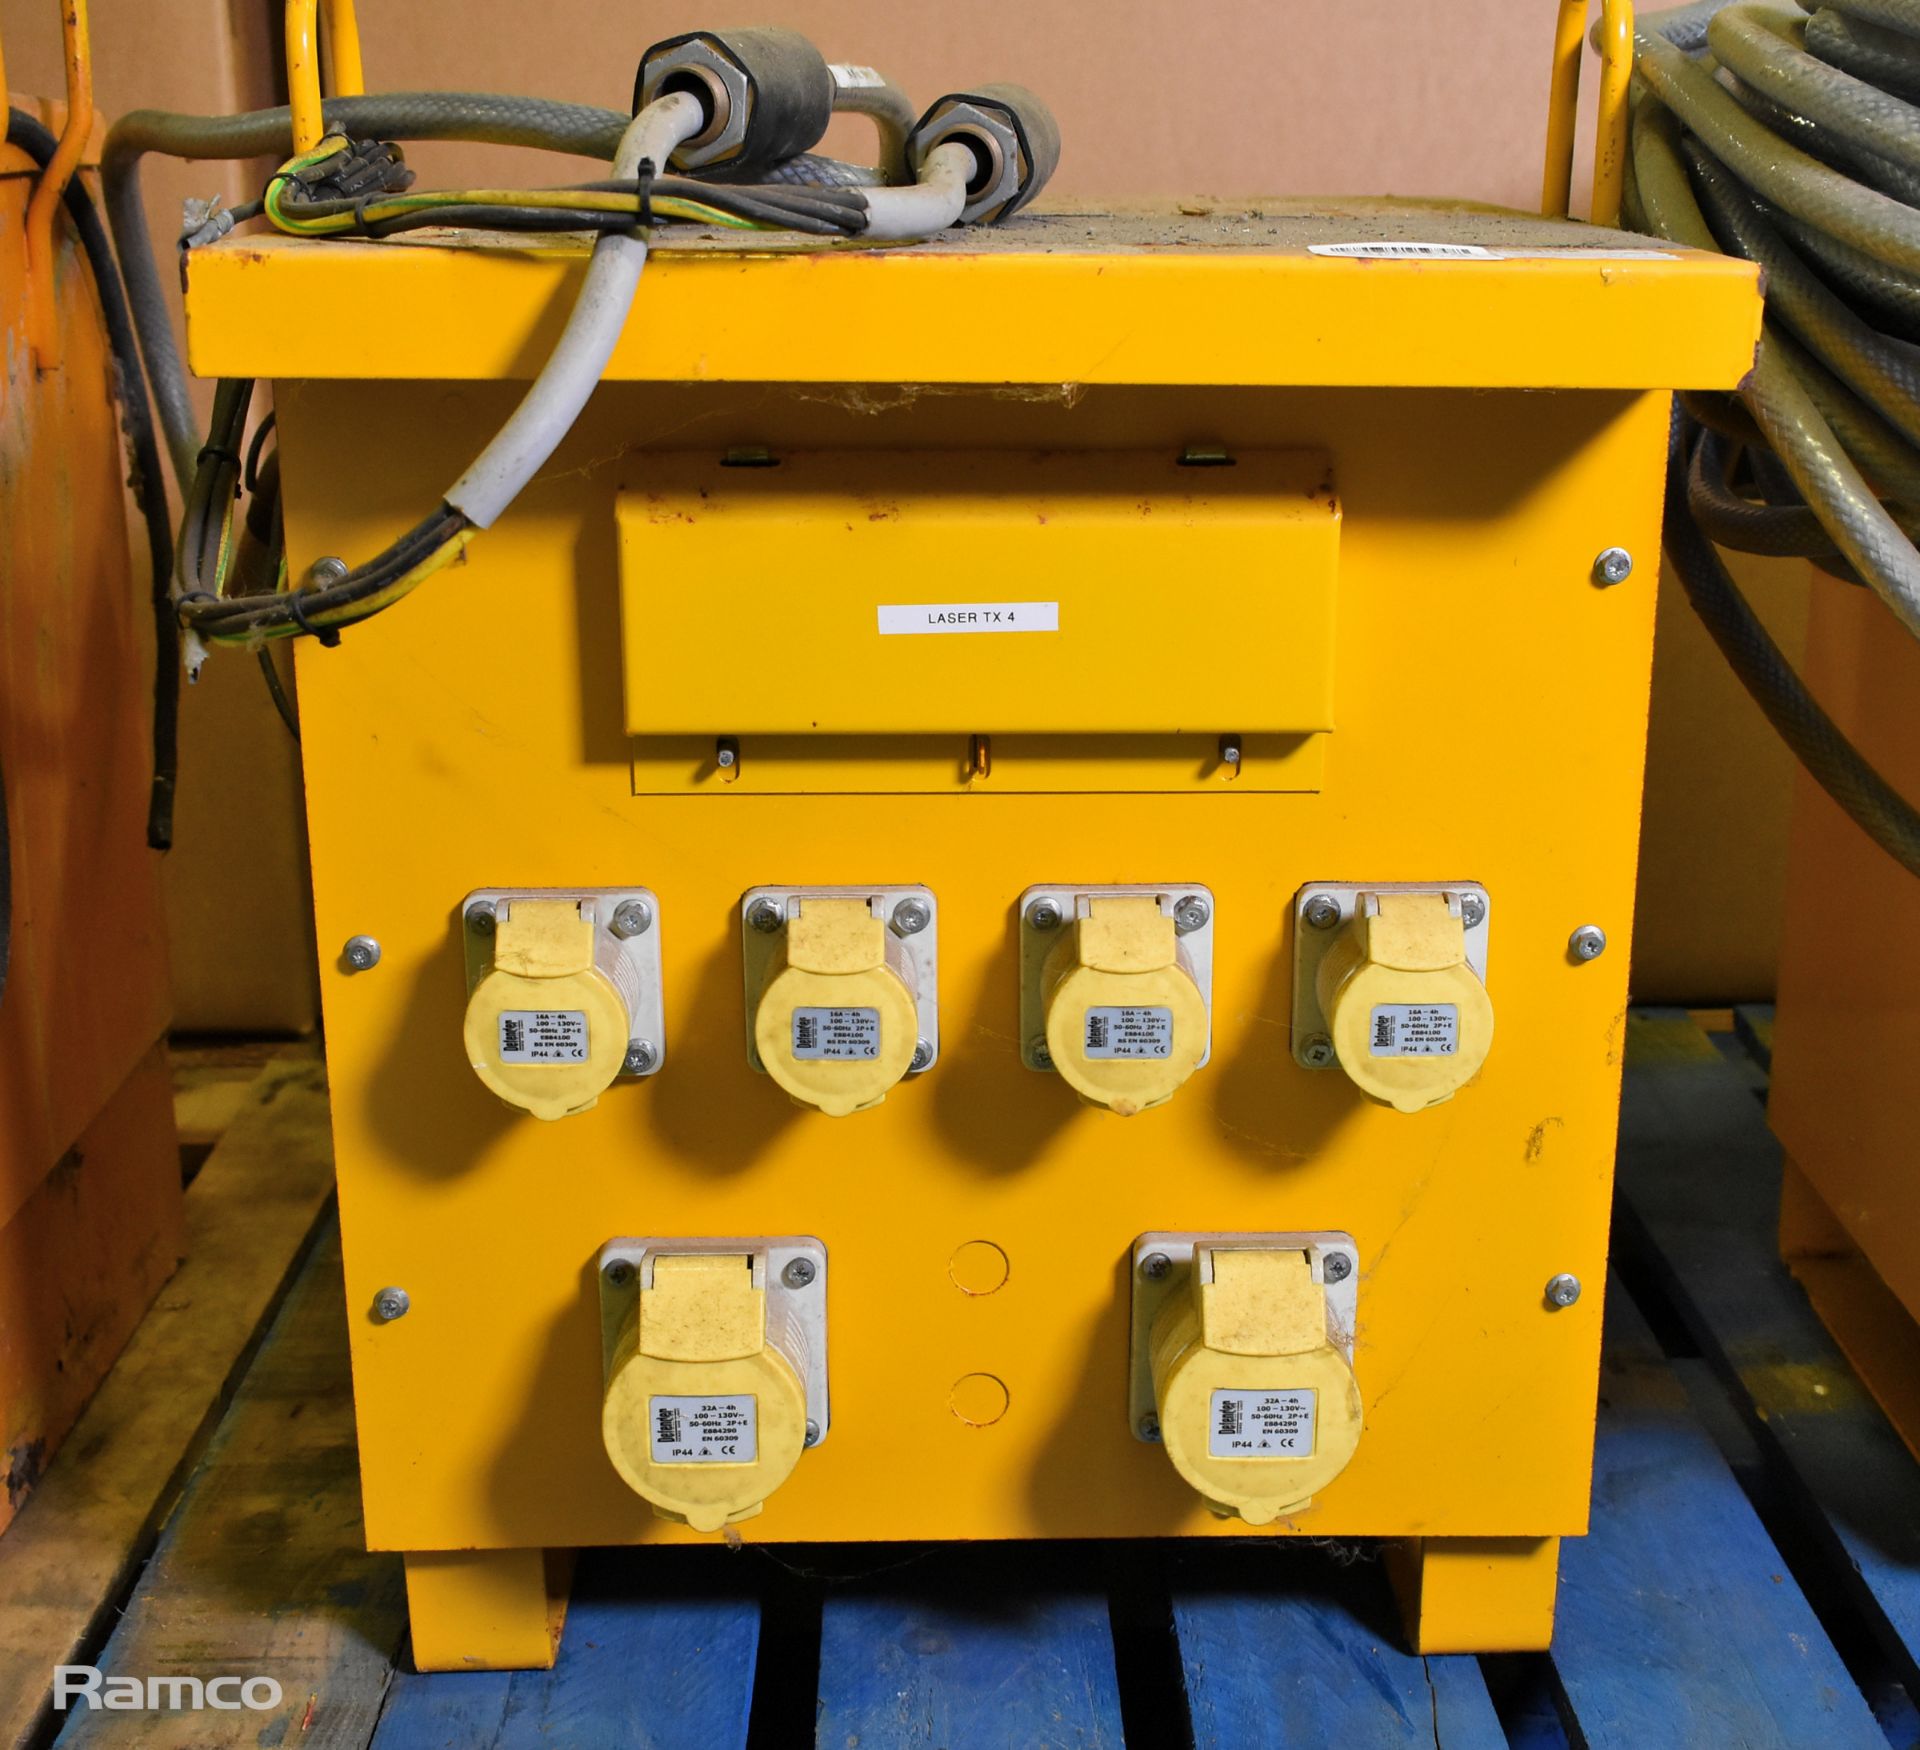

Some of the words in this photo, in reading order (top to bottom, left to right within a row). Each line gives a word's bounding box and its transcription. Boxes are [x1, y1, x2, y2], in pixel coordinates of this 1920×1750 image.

[929, 613, 977, 624] LASER
[984, 612, 1001, 622] TX
[1008, 612, 1014, 621] 4
[503, 1020, 518, 1051] Defender
[796, 1017, 811, 1048] Defender
[1087, 1017, 1102, 1047] Defender
[1374, 1016, 1389, 1046] Defender
[571, 1049, 583, 1057] CE
[864, 1047, 875, 1055] CE
[656, 1408, 675, 1442] Defender
[1219, 1401, 1237, 1434] Defender
[721, 1446, 735, 1454] CE
[1281, 1439, 1294, 1447] CE
